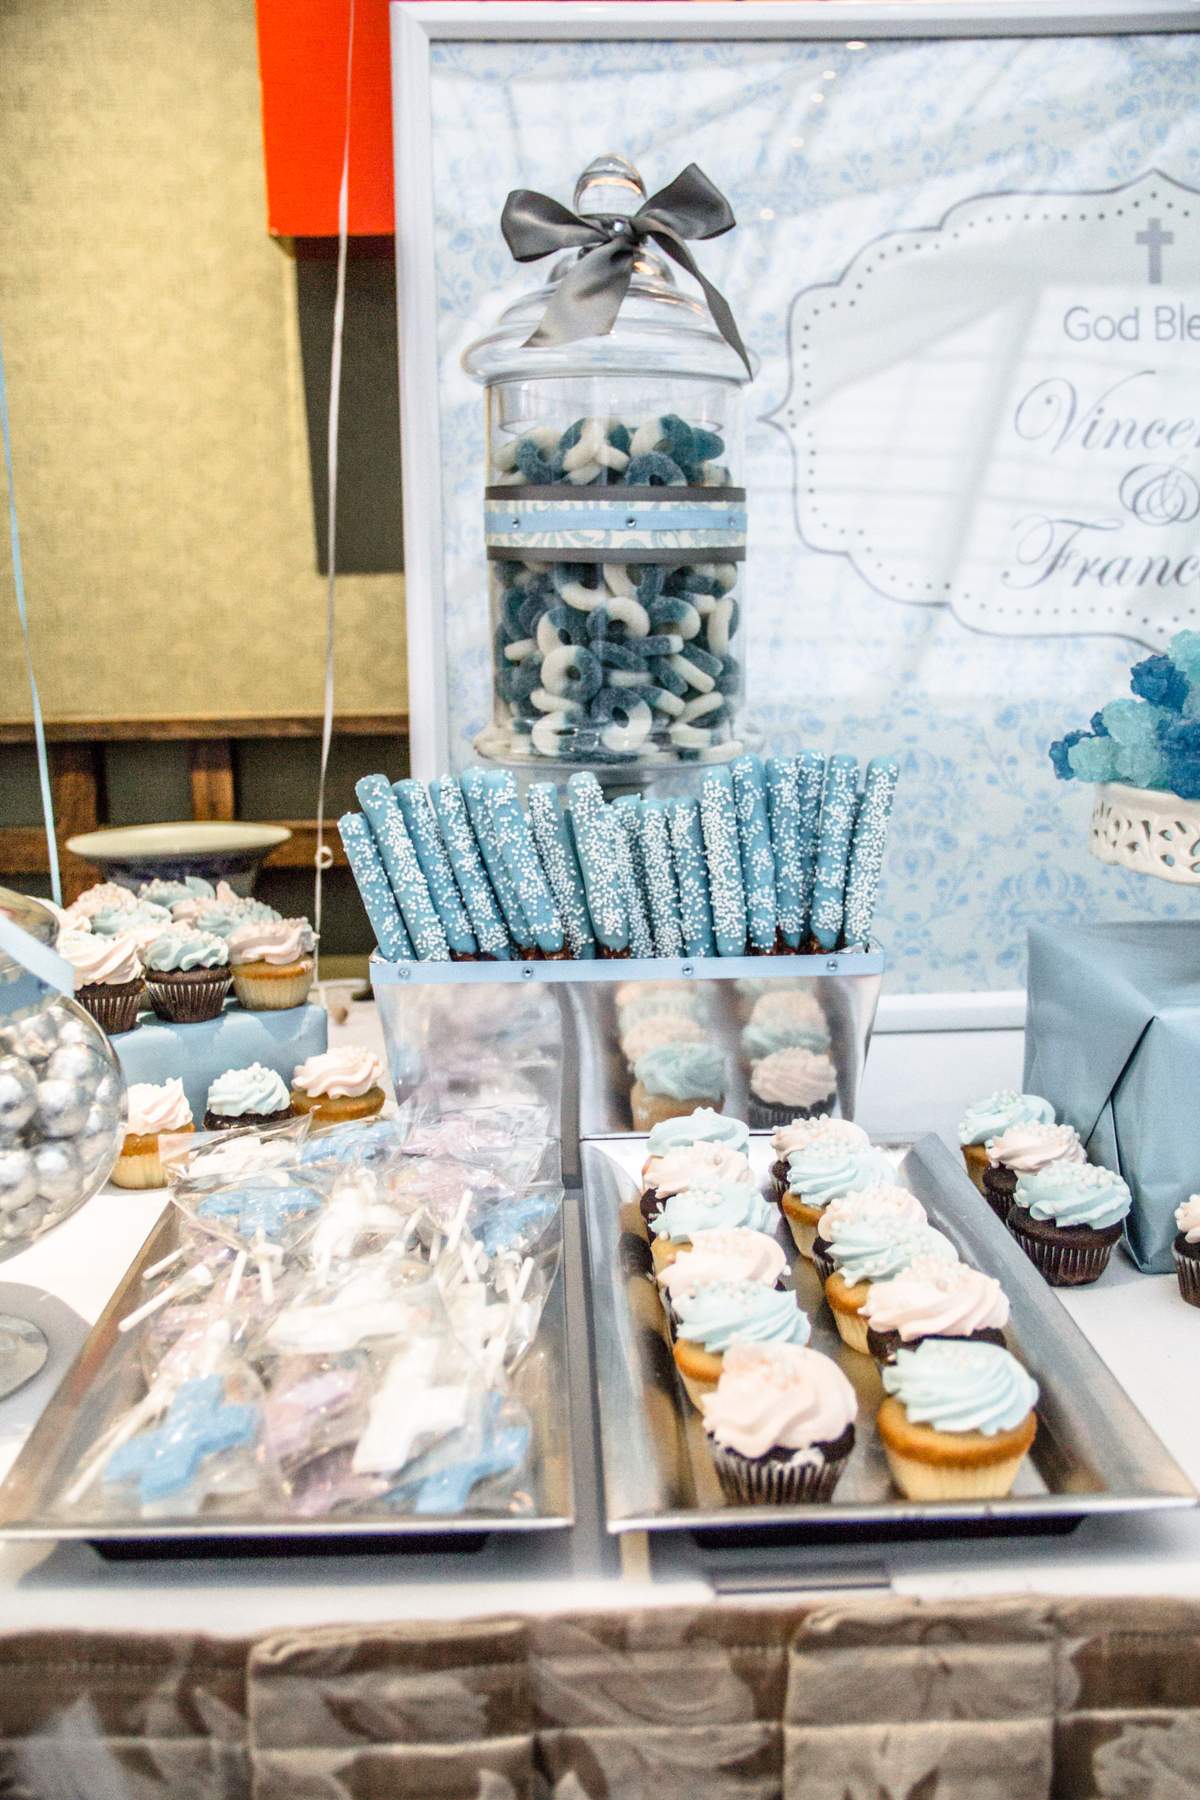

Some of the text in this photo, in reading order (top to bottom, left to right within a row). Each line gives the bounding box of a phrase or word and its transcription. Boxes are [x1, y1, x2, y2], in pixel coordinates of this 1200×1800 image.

[1063, 305, 1140, 342] God
[1014, 369, 1200, 453] Vince
[1119, 454, 1200, 526] &
